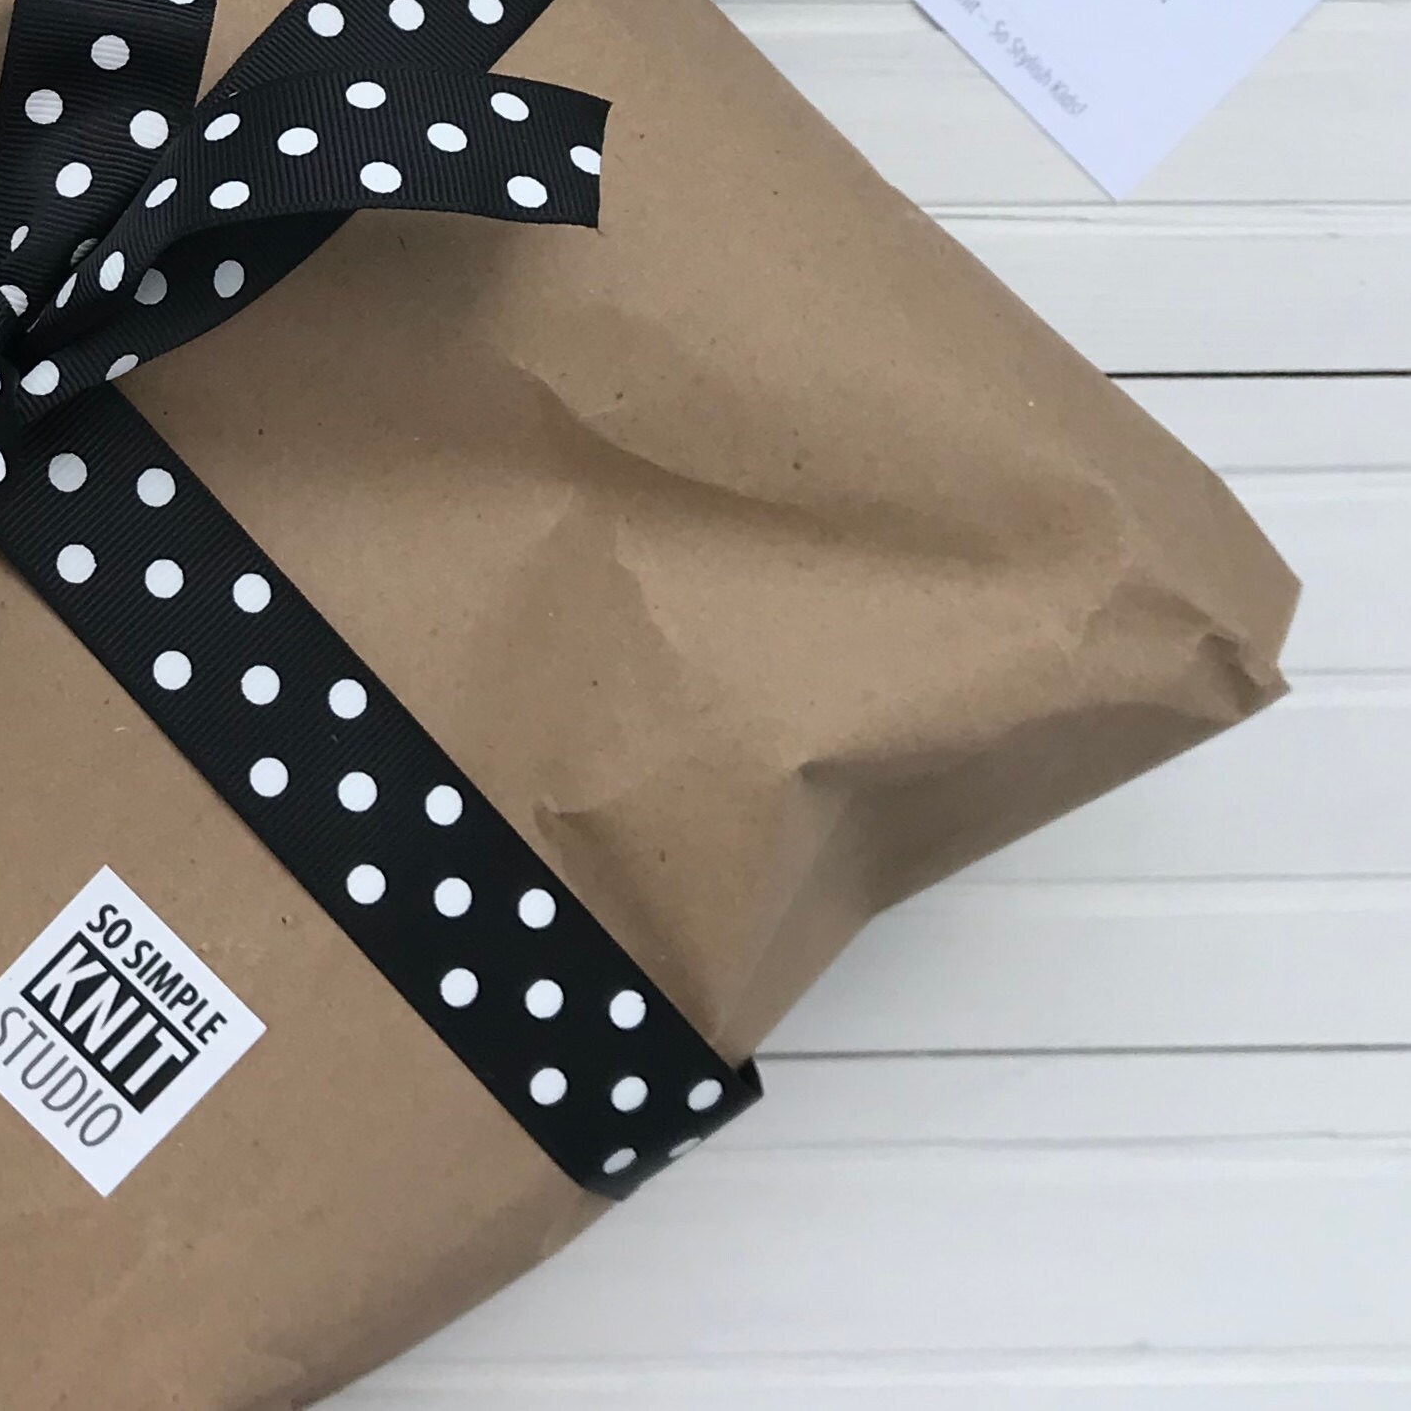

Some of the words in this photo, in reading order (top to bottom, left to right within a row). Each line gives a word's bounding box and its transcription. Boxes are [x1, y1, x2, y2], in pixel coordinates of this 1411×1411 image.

[989, 20, 1009, 43] So
[30, 940, 190, 1097] KNIT
[86, 904, 133, 949] SO
[122, 939, 228, 1046] SIMPLE
